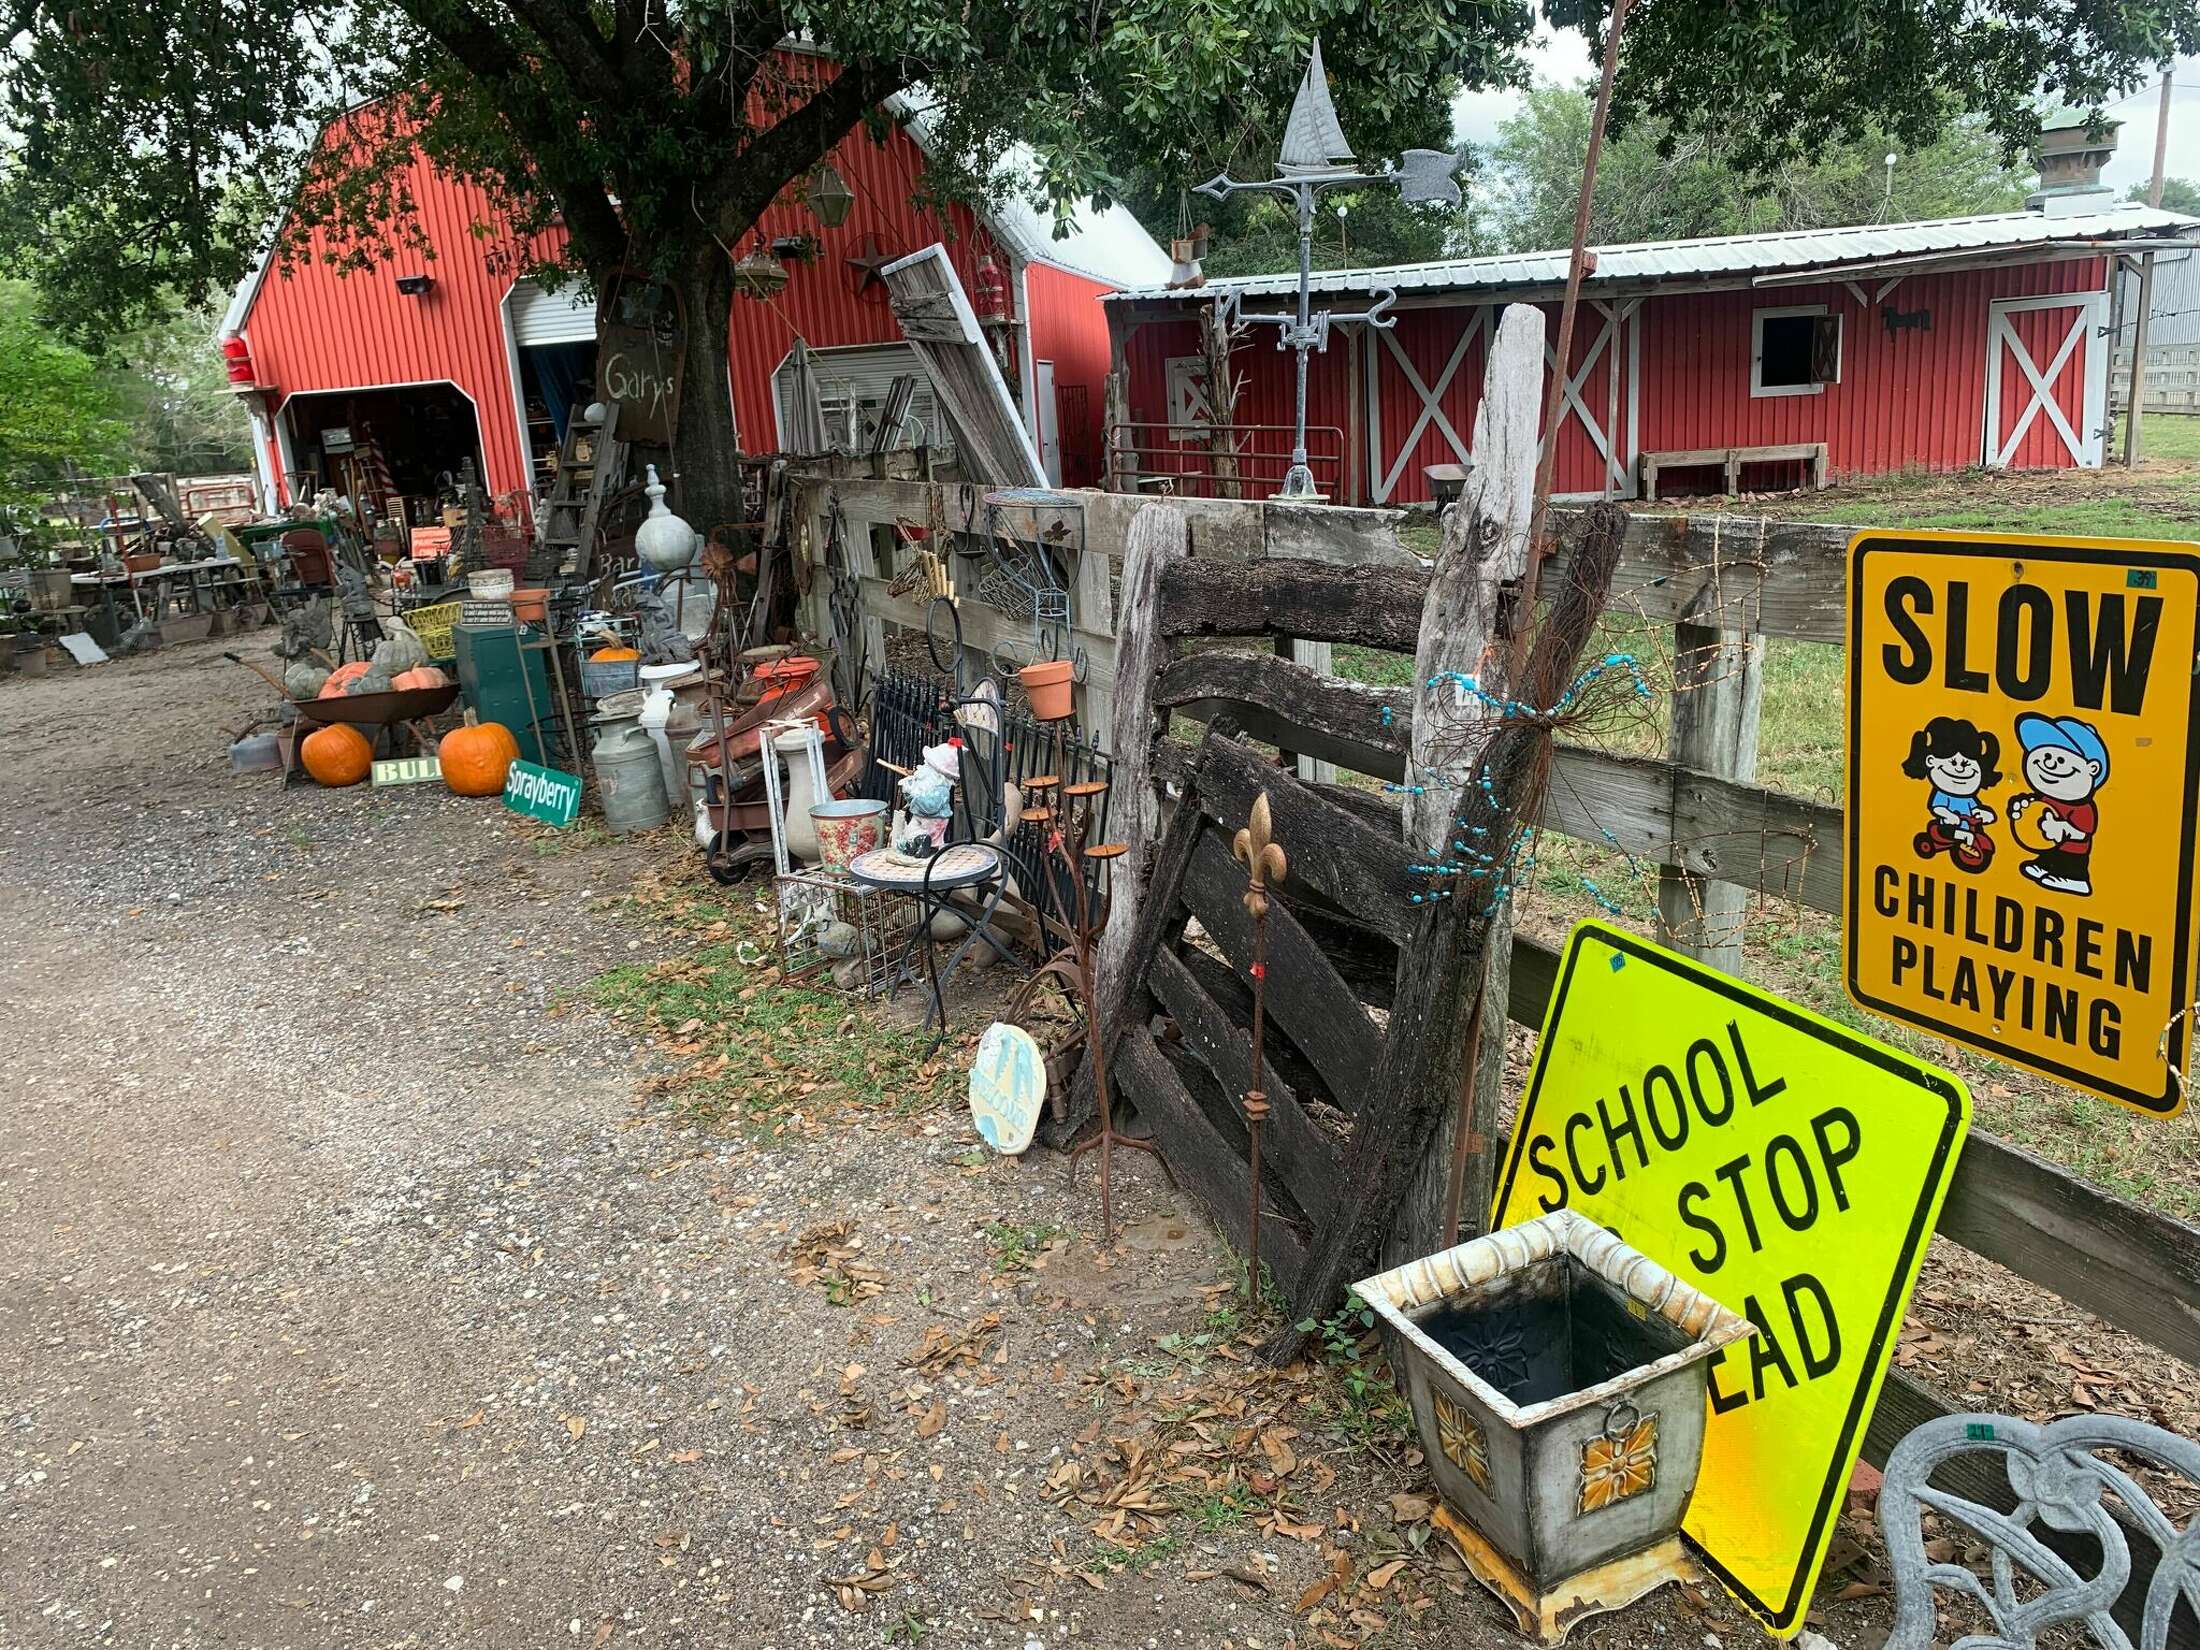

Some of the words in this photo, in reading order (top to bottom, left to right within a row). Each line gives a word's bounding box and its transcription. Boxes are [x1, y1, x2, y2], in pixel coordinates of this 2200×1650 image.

[1882, 575, 2164, 717] SLOW
[507, 761, 576, 822] Sprayberry
[1874, 864, 2152, 995] CHILDREN
[1892, 935, 2122, 1061] PLAYING
[1528, 1018, 1787, 1214] SCHOOL
[1677, 1106, 1861, 1274] STOP
[1707, 1273, 1842, 1415] EAD
